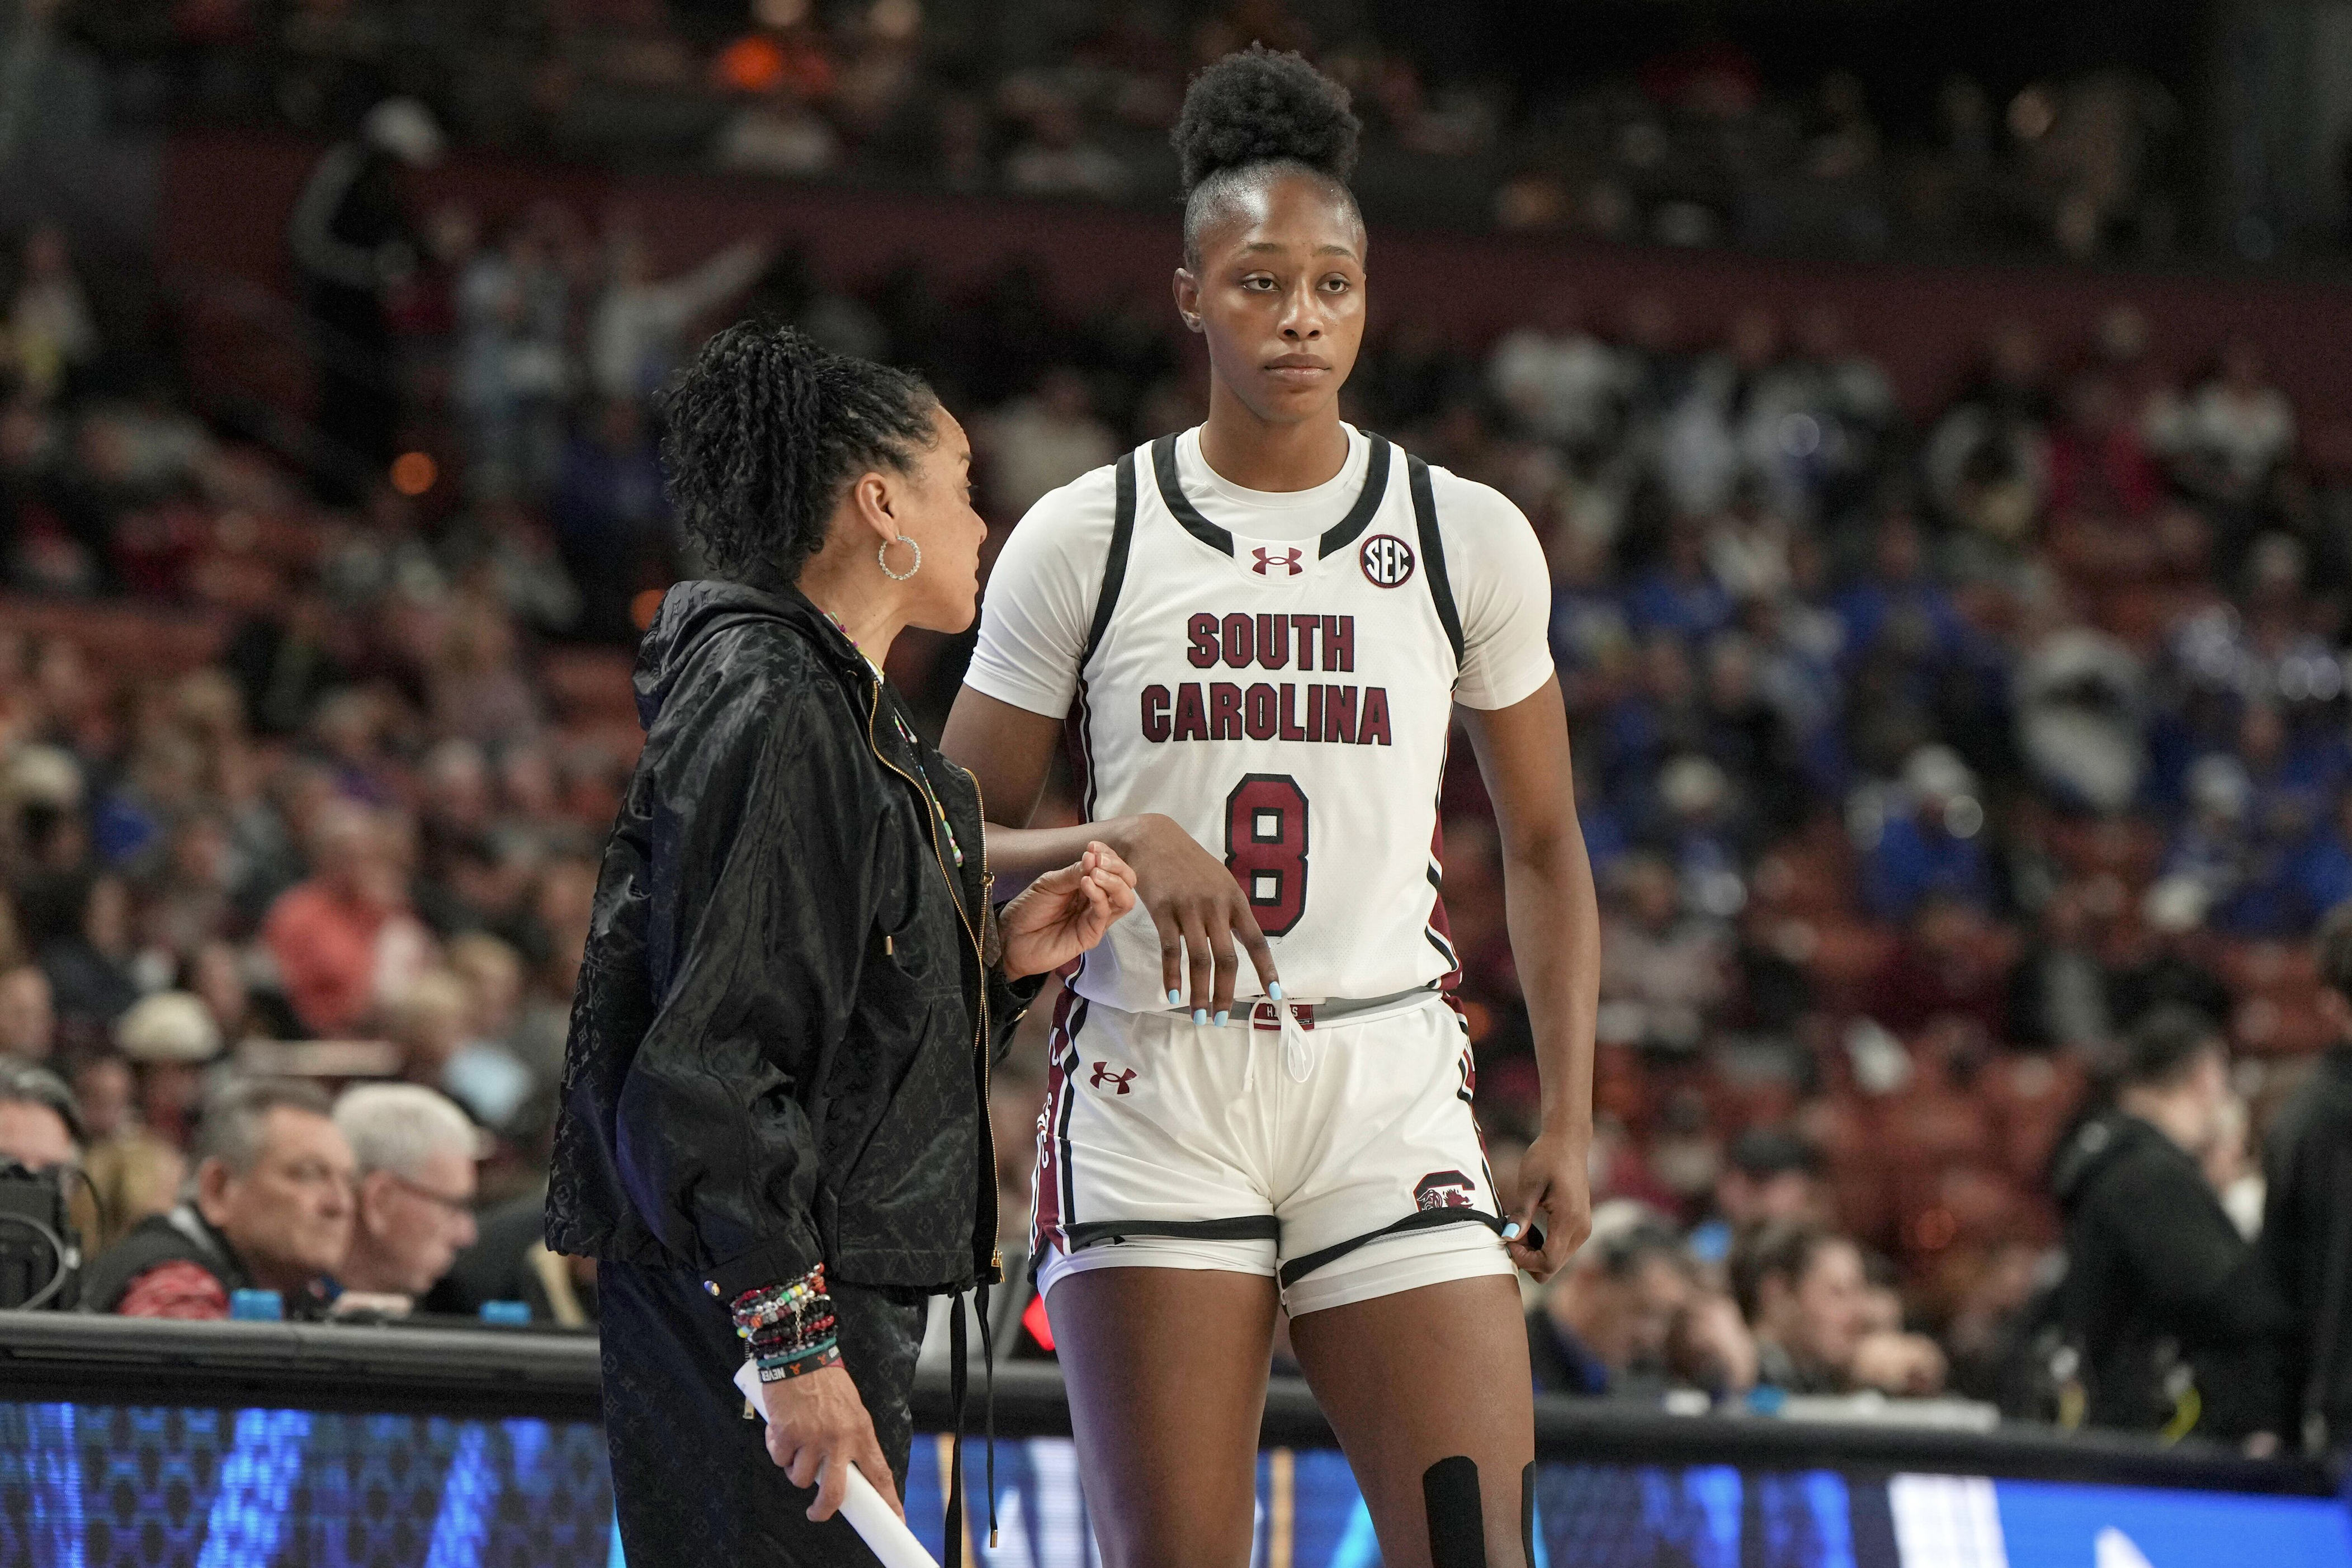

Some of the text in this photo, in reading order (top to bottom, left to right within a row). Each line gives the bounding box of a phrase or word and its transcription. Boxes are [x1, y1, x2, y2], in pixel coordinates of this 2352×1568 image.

[1367, 537, 1409, 583] SEC
[1187, 612, 1354, 673] SOUTH
[1141, 682, 1392, 746] CAROLINA
[1225, 773, 1309, 937] 8
